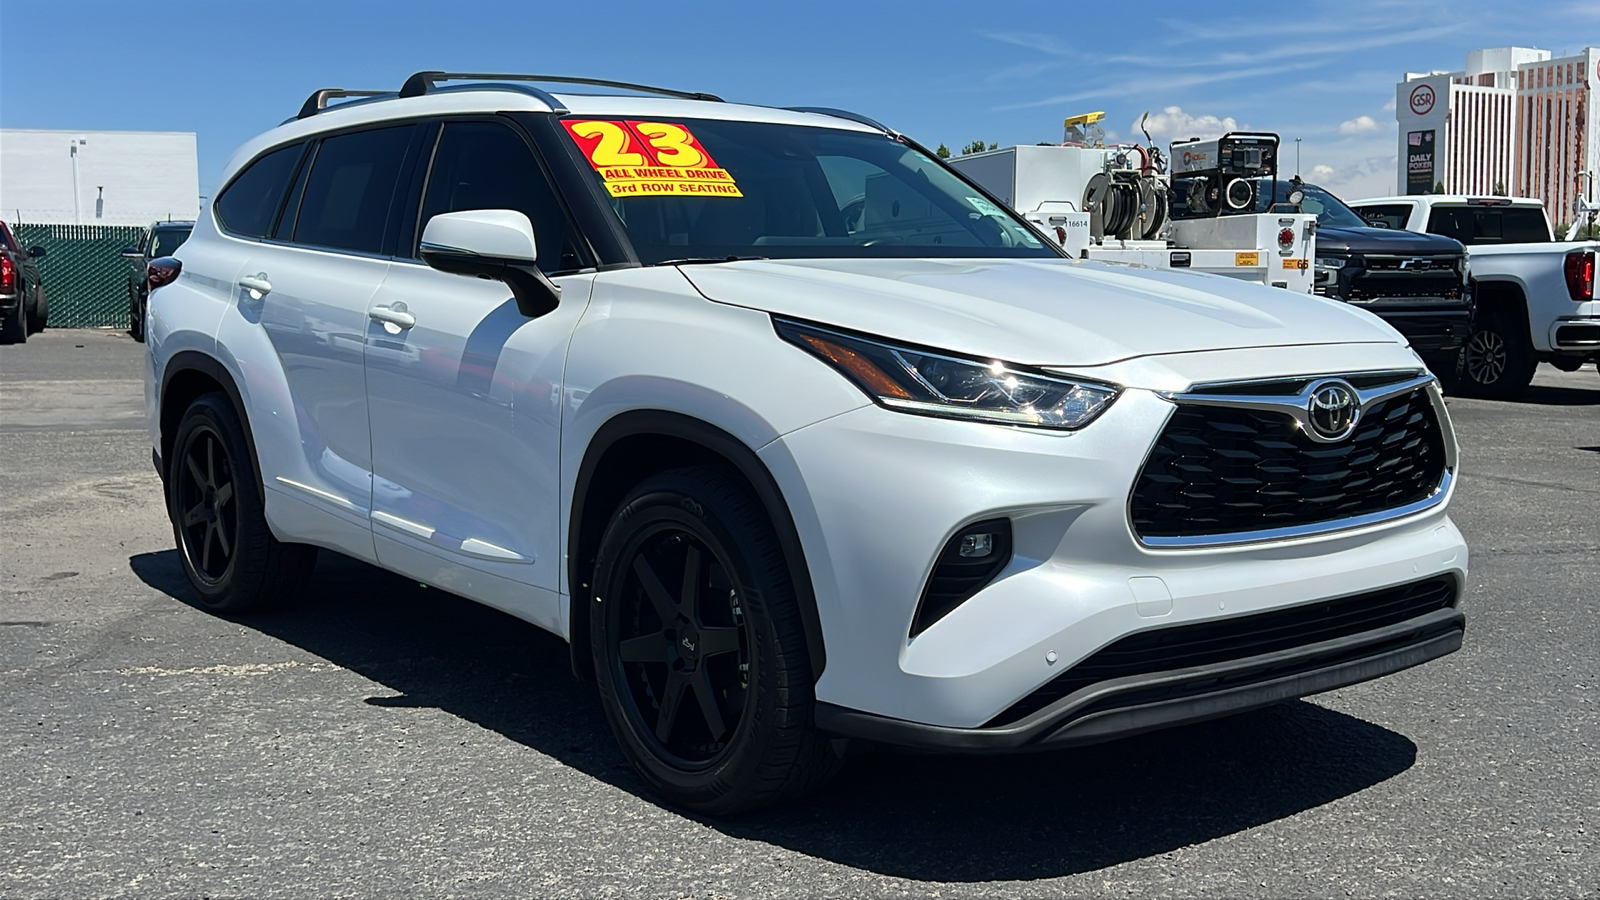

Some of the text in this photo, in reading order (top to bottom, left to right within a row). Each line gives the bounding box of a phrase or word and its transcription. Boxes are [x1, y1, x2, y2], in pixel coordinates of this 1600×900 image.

[1413, 93, 1431, 106] GSR
[571, 121, 708, 168] 23
[1410, 153, 1431, 162] DAILY
[1409, 161, 1432, 169] POKER
[605, 168, 728, 179] ALL WHEEL DRIVE
[612, 183, 737, 194] 3rd ROW SEATING
